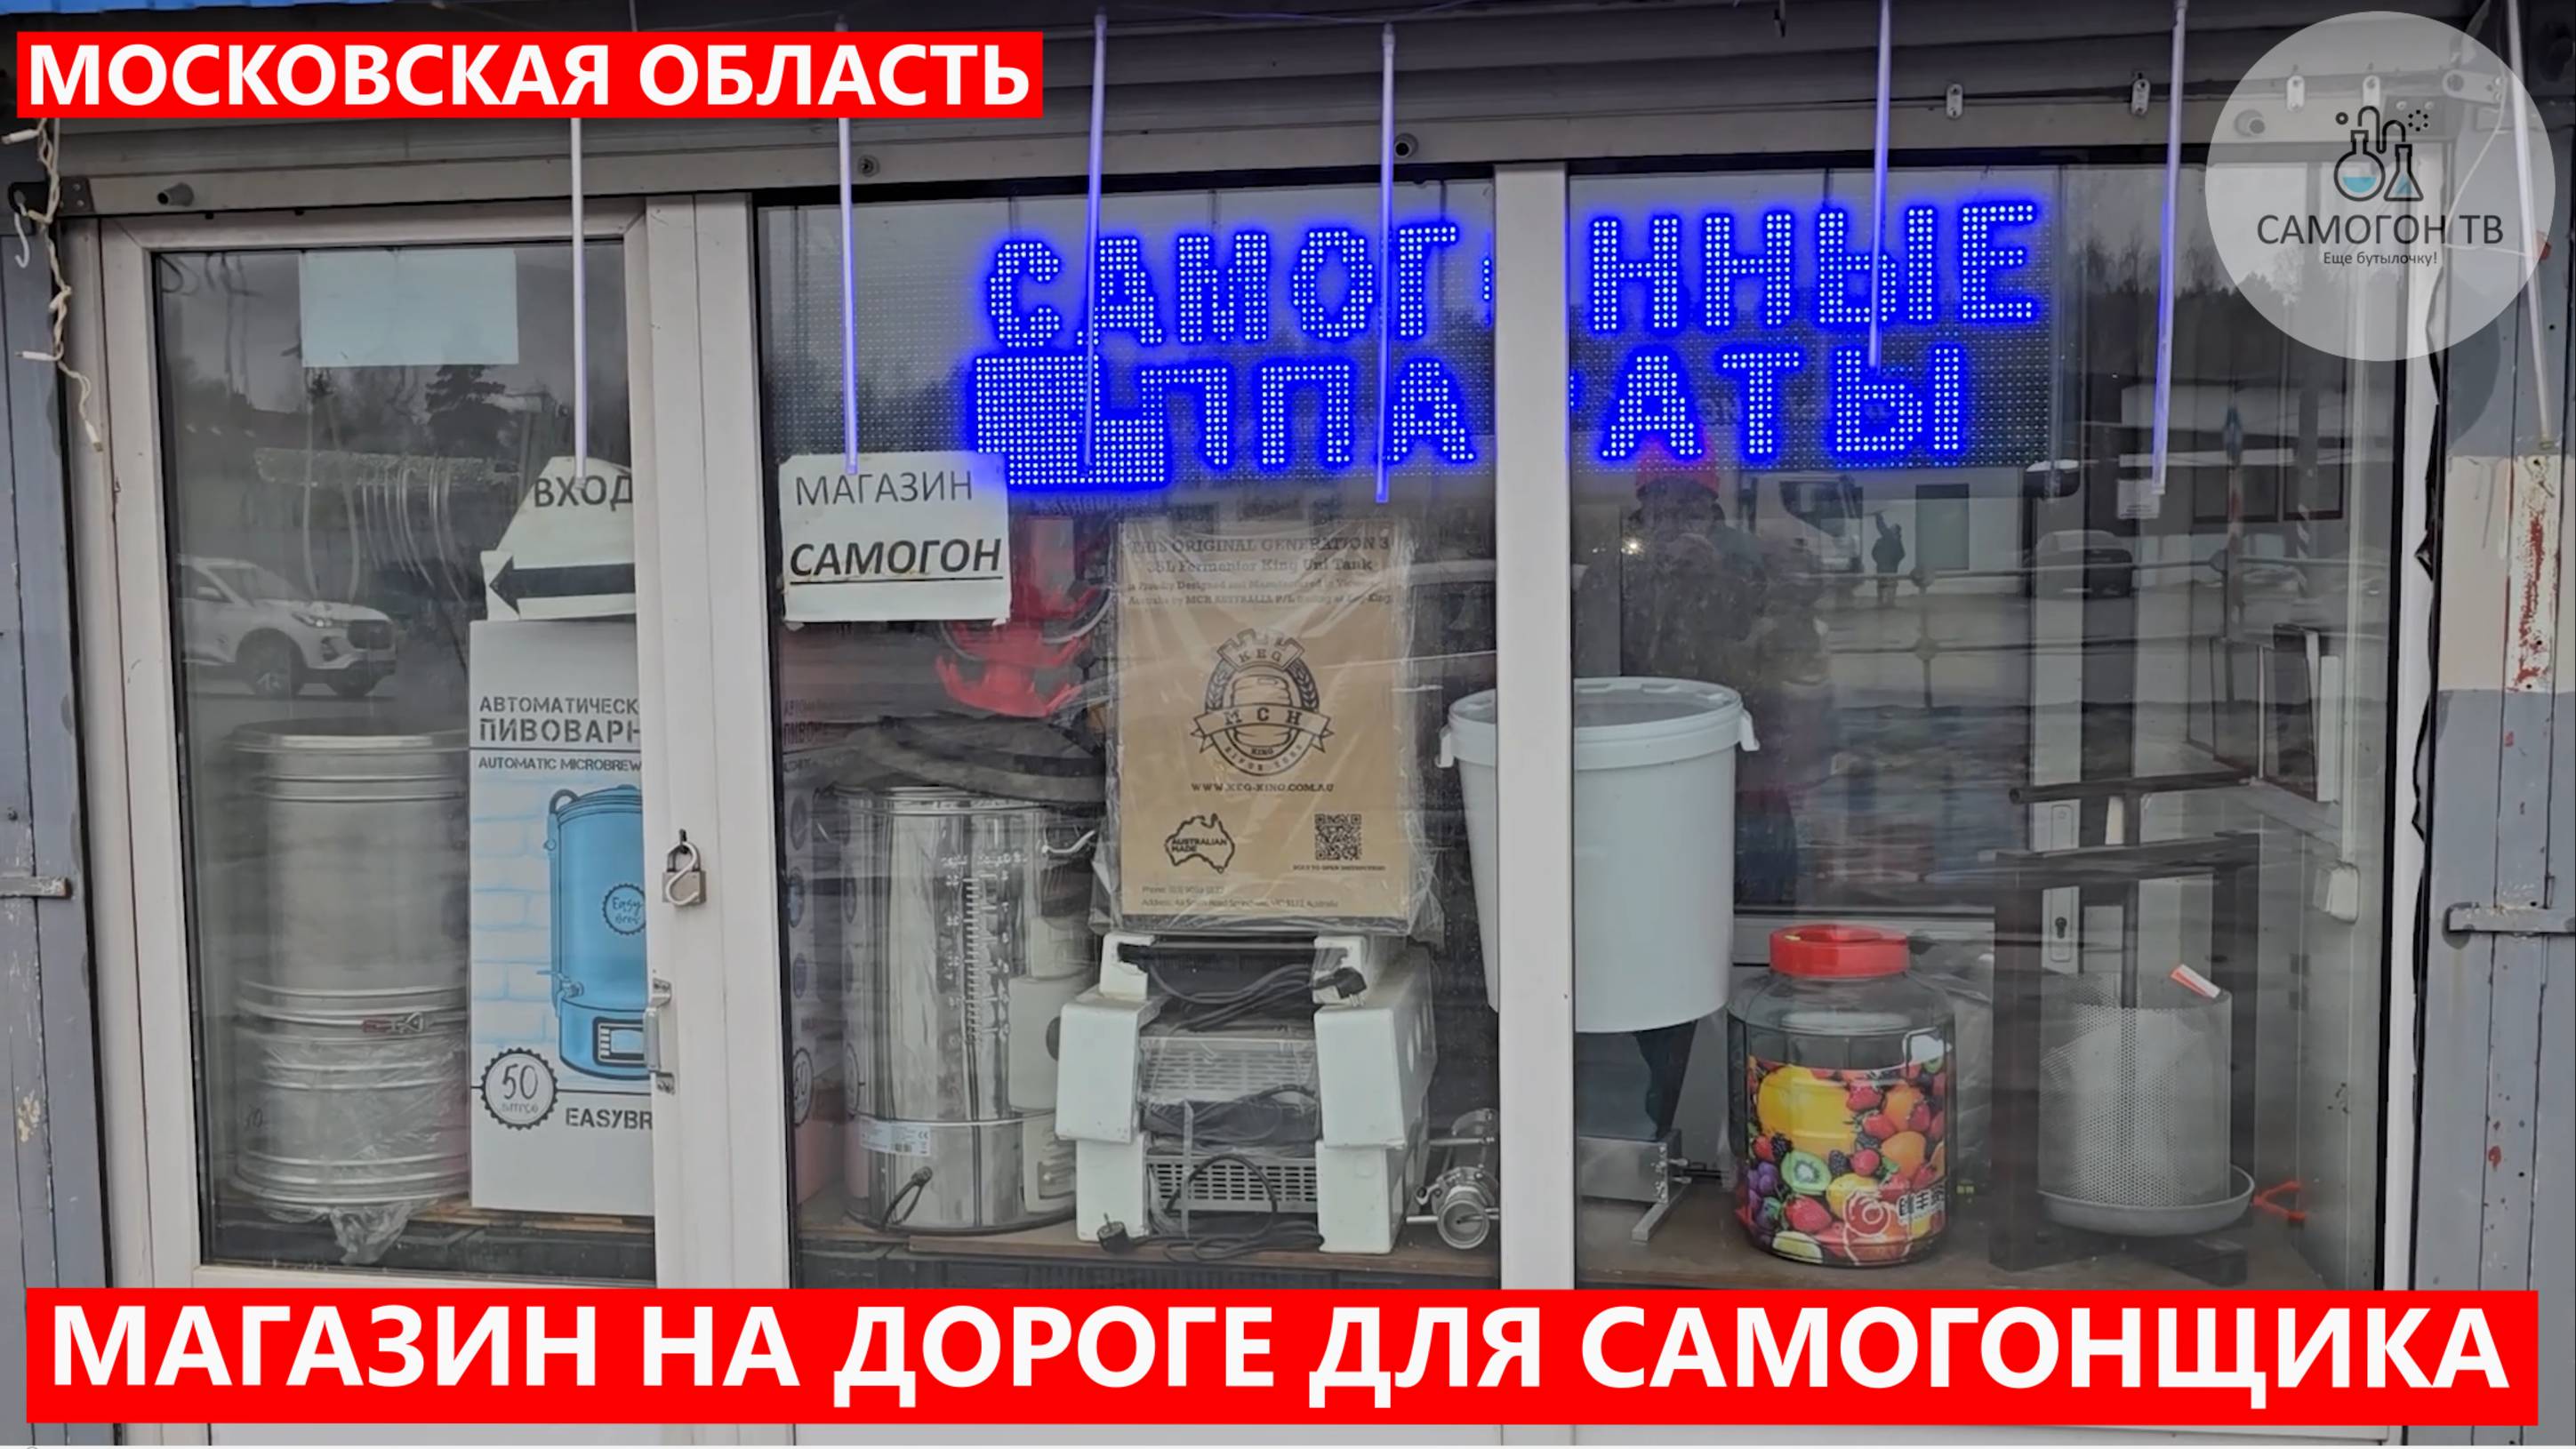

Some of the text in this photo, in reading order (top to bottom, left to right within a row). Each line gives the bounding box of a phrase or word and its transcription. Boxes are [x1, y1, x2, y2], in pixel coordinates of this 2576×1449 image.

[990, 204, 2036, 348] САМОГННЫЕ
[534, 475, 633, 512] ВХОД
[796, 470, 973, 506] МАГАЗИН
[1172, 539, 1256, 553] ORIGINAL
[1261, 537, 1375, 551] GENERATION
[1379, 537, 1389, 549] 3
[790, 538, 1002, 577] САМОГОН
[1261, 558, 1298, 574] King
[1335, 557, 1373, 571] Tank
[1239, 648, 1283, 663] KEG
[478, 757, 642, 772] AUTOMATIC MICROBREW
[1172, 838, 1228, 846] AUSTRALIAN
[502, 1062, 539, 1101] 50
[566, 1108, 653, 1131] EASYBR
